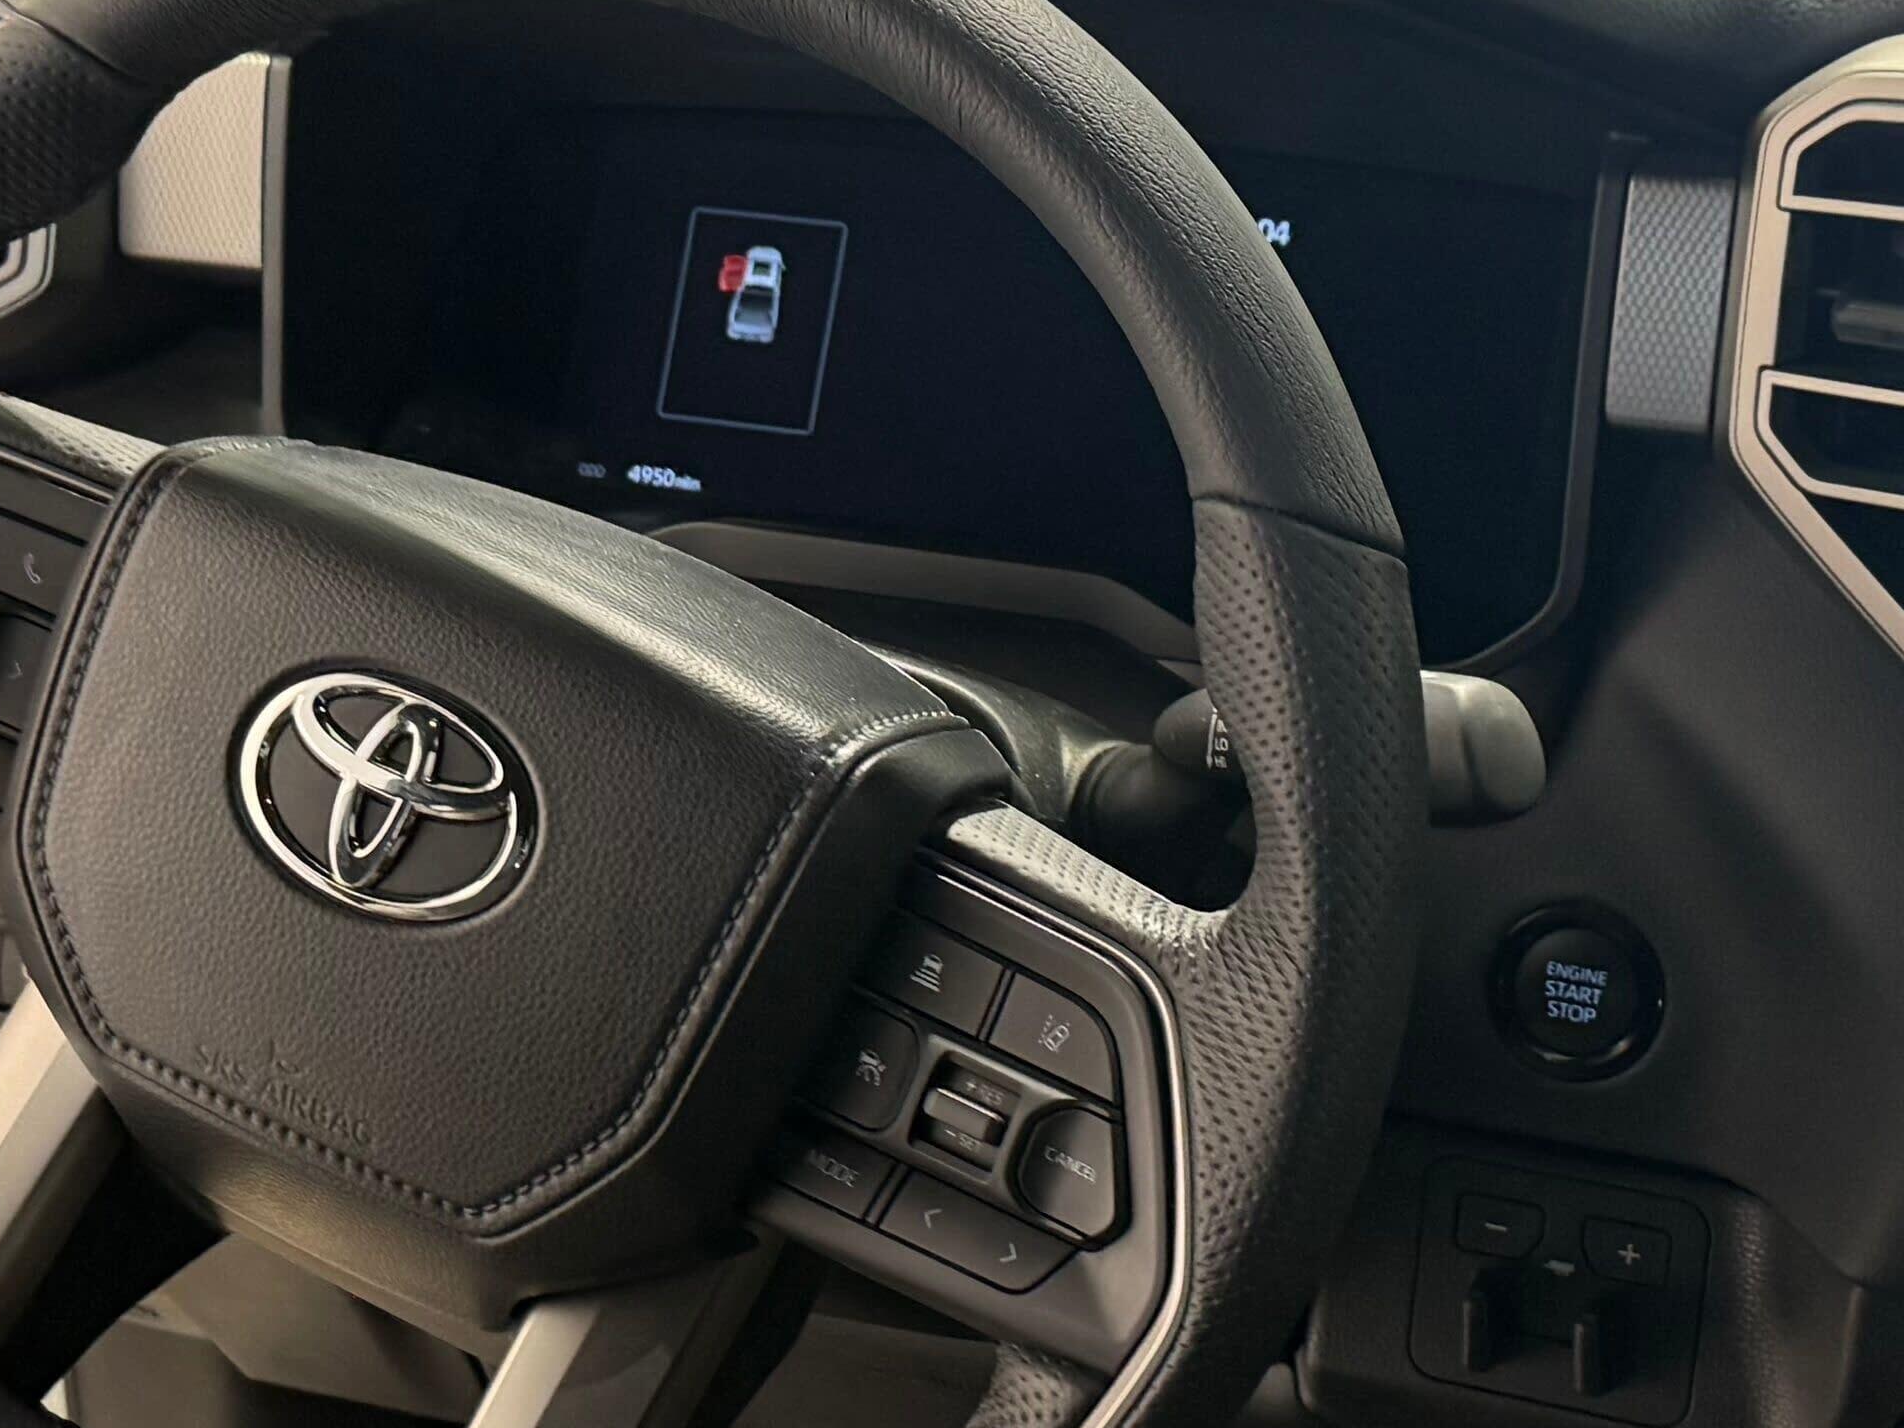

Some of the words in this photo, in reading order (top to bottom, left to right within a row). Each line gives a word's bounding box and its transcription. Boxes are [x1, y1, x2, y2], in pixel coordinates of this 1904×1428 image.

[1546, 960, 1608, 987] ENGINE
[1545, 980, 1603, 1005] START
[1548, 999, 1597, 1023] STOP
